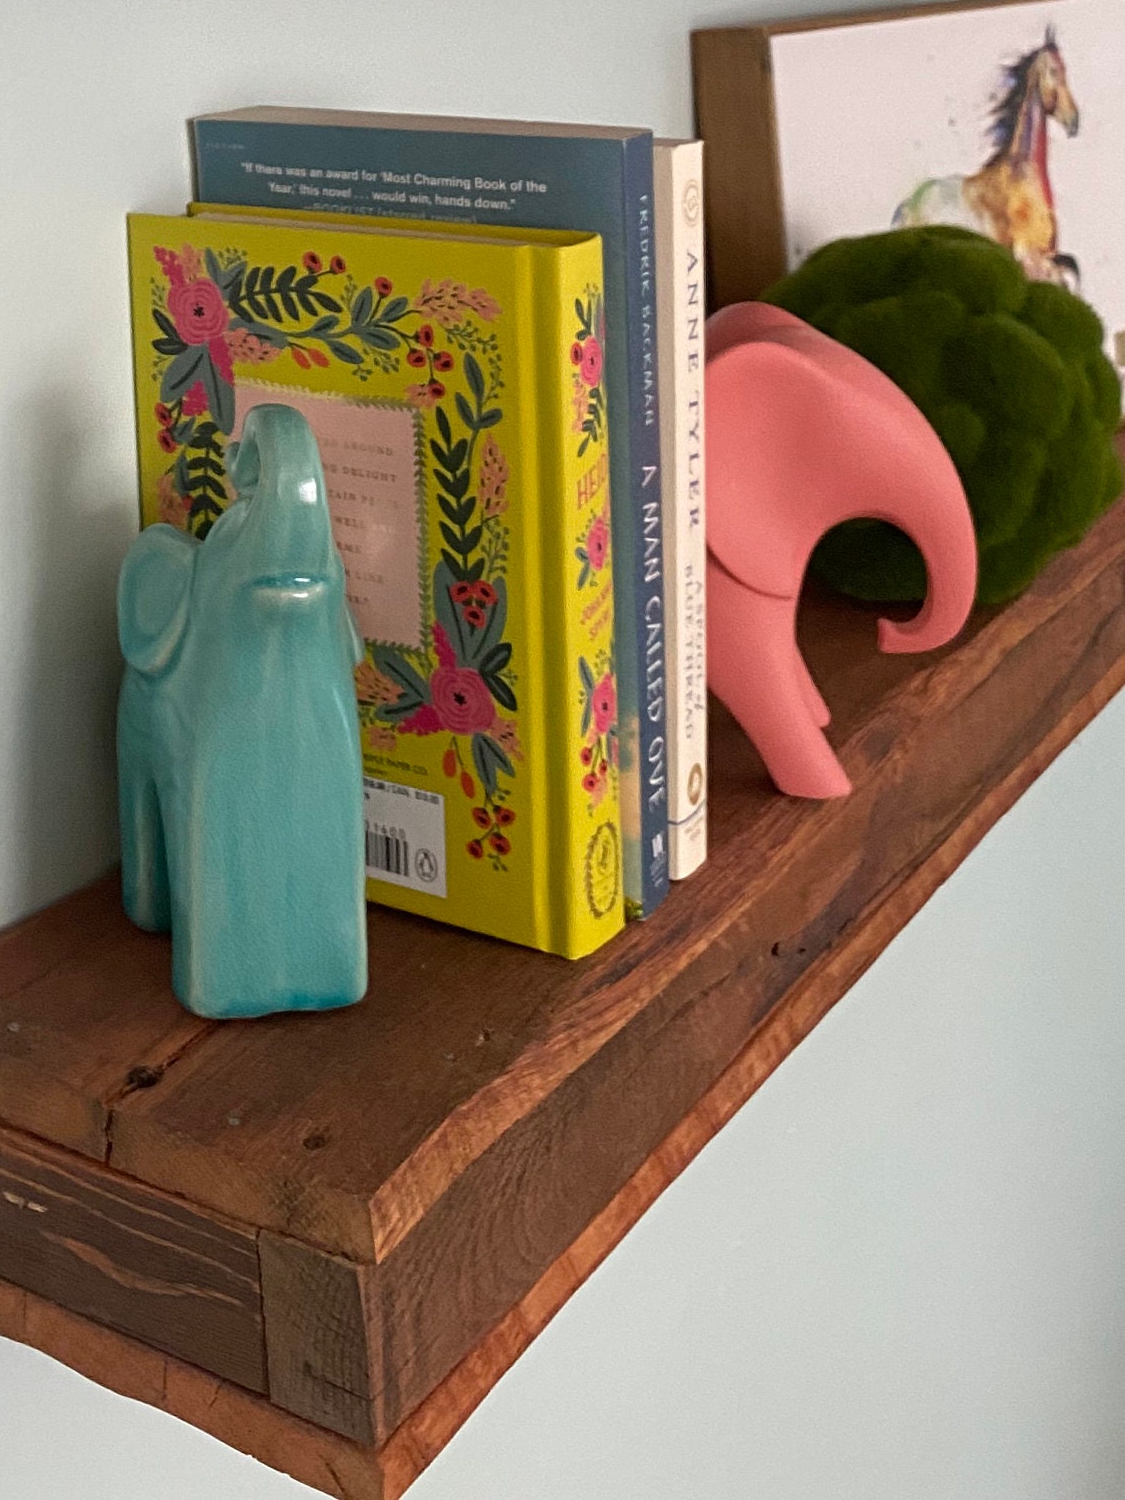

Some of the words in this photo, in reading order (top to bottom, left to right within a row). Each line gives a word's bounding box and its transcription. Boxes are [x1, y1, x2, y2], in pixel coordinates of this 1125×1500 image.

[256, 164, 283, 176] there
[286, 168, 306, 177] was
[310, 169, 323, 178] an
[325, 168, 358, 180] award
[361, 170, 377, 182] for
[414, 173, 471, 190] Charming
[475, 177, 506, 190] Book
[510, 180, 523, 192] of
[526, 180, 547, 193] the
[299, 183, 319, 196] this
[322, 186, 352, 198] novel
[371, 191, 406, 203] would
[435, 194, 471, 207] hands
[687, 252, 700, 373] ANNE
[642, 304, 655, 426] BACKMAN
[343, 466, 398, 482] DELIGHT
[689, 390, 701, 527] TYLER
[642, 502, 661, 583] MAN
[645, 595, 664, 723] CALLED
